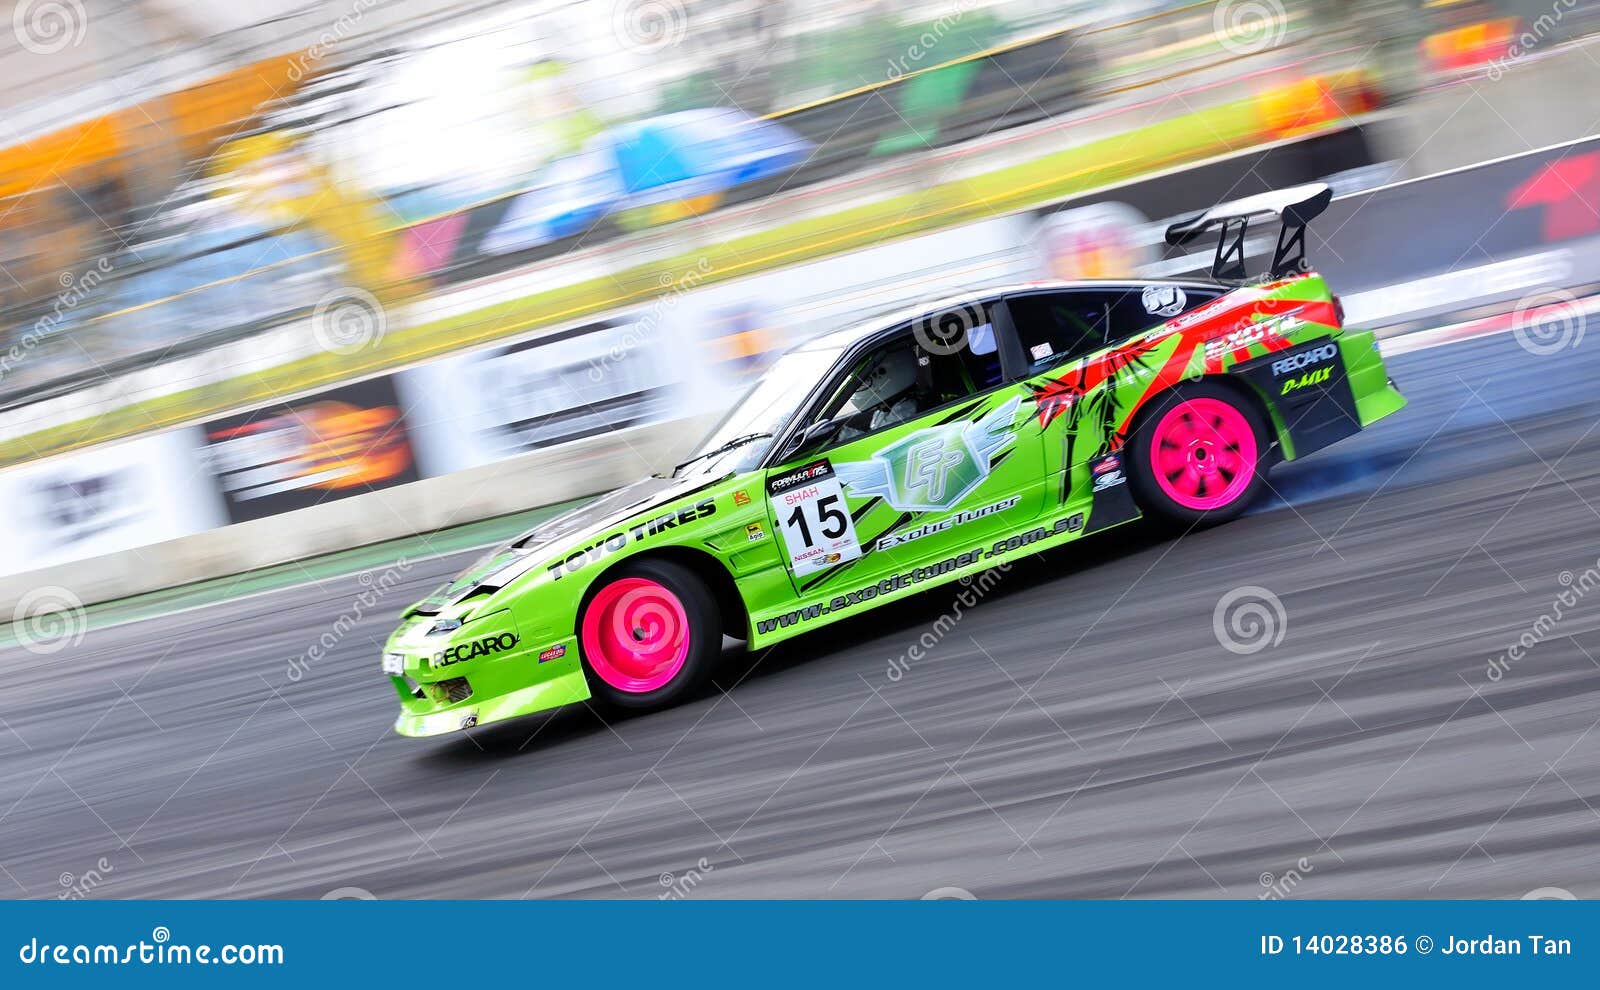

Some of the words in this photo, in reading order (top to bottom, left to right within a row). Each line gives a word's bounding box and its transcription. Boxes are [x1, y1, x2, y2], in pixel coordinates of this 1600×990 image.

[1271, 343, 1338, 376] RECARO
[785, 486, 819, 506] SHAH
[749, 532, 763, 541] Agip
[787, 494, 848, 548] 15
[547, 532, 627, 581] TOYO
[629, 497, 717, 542] TIRES
[794, 547, 825, 562] NISSAN
[433, 632, 519, 669] RECARO
